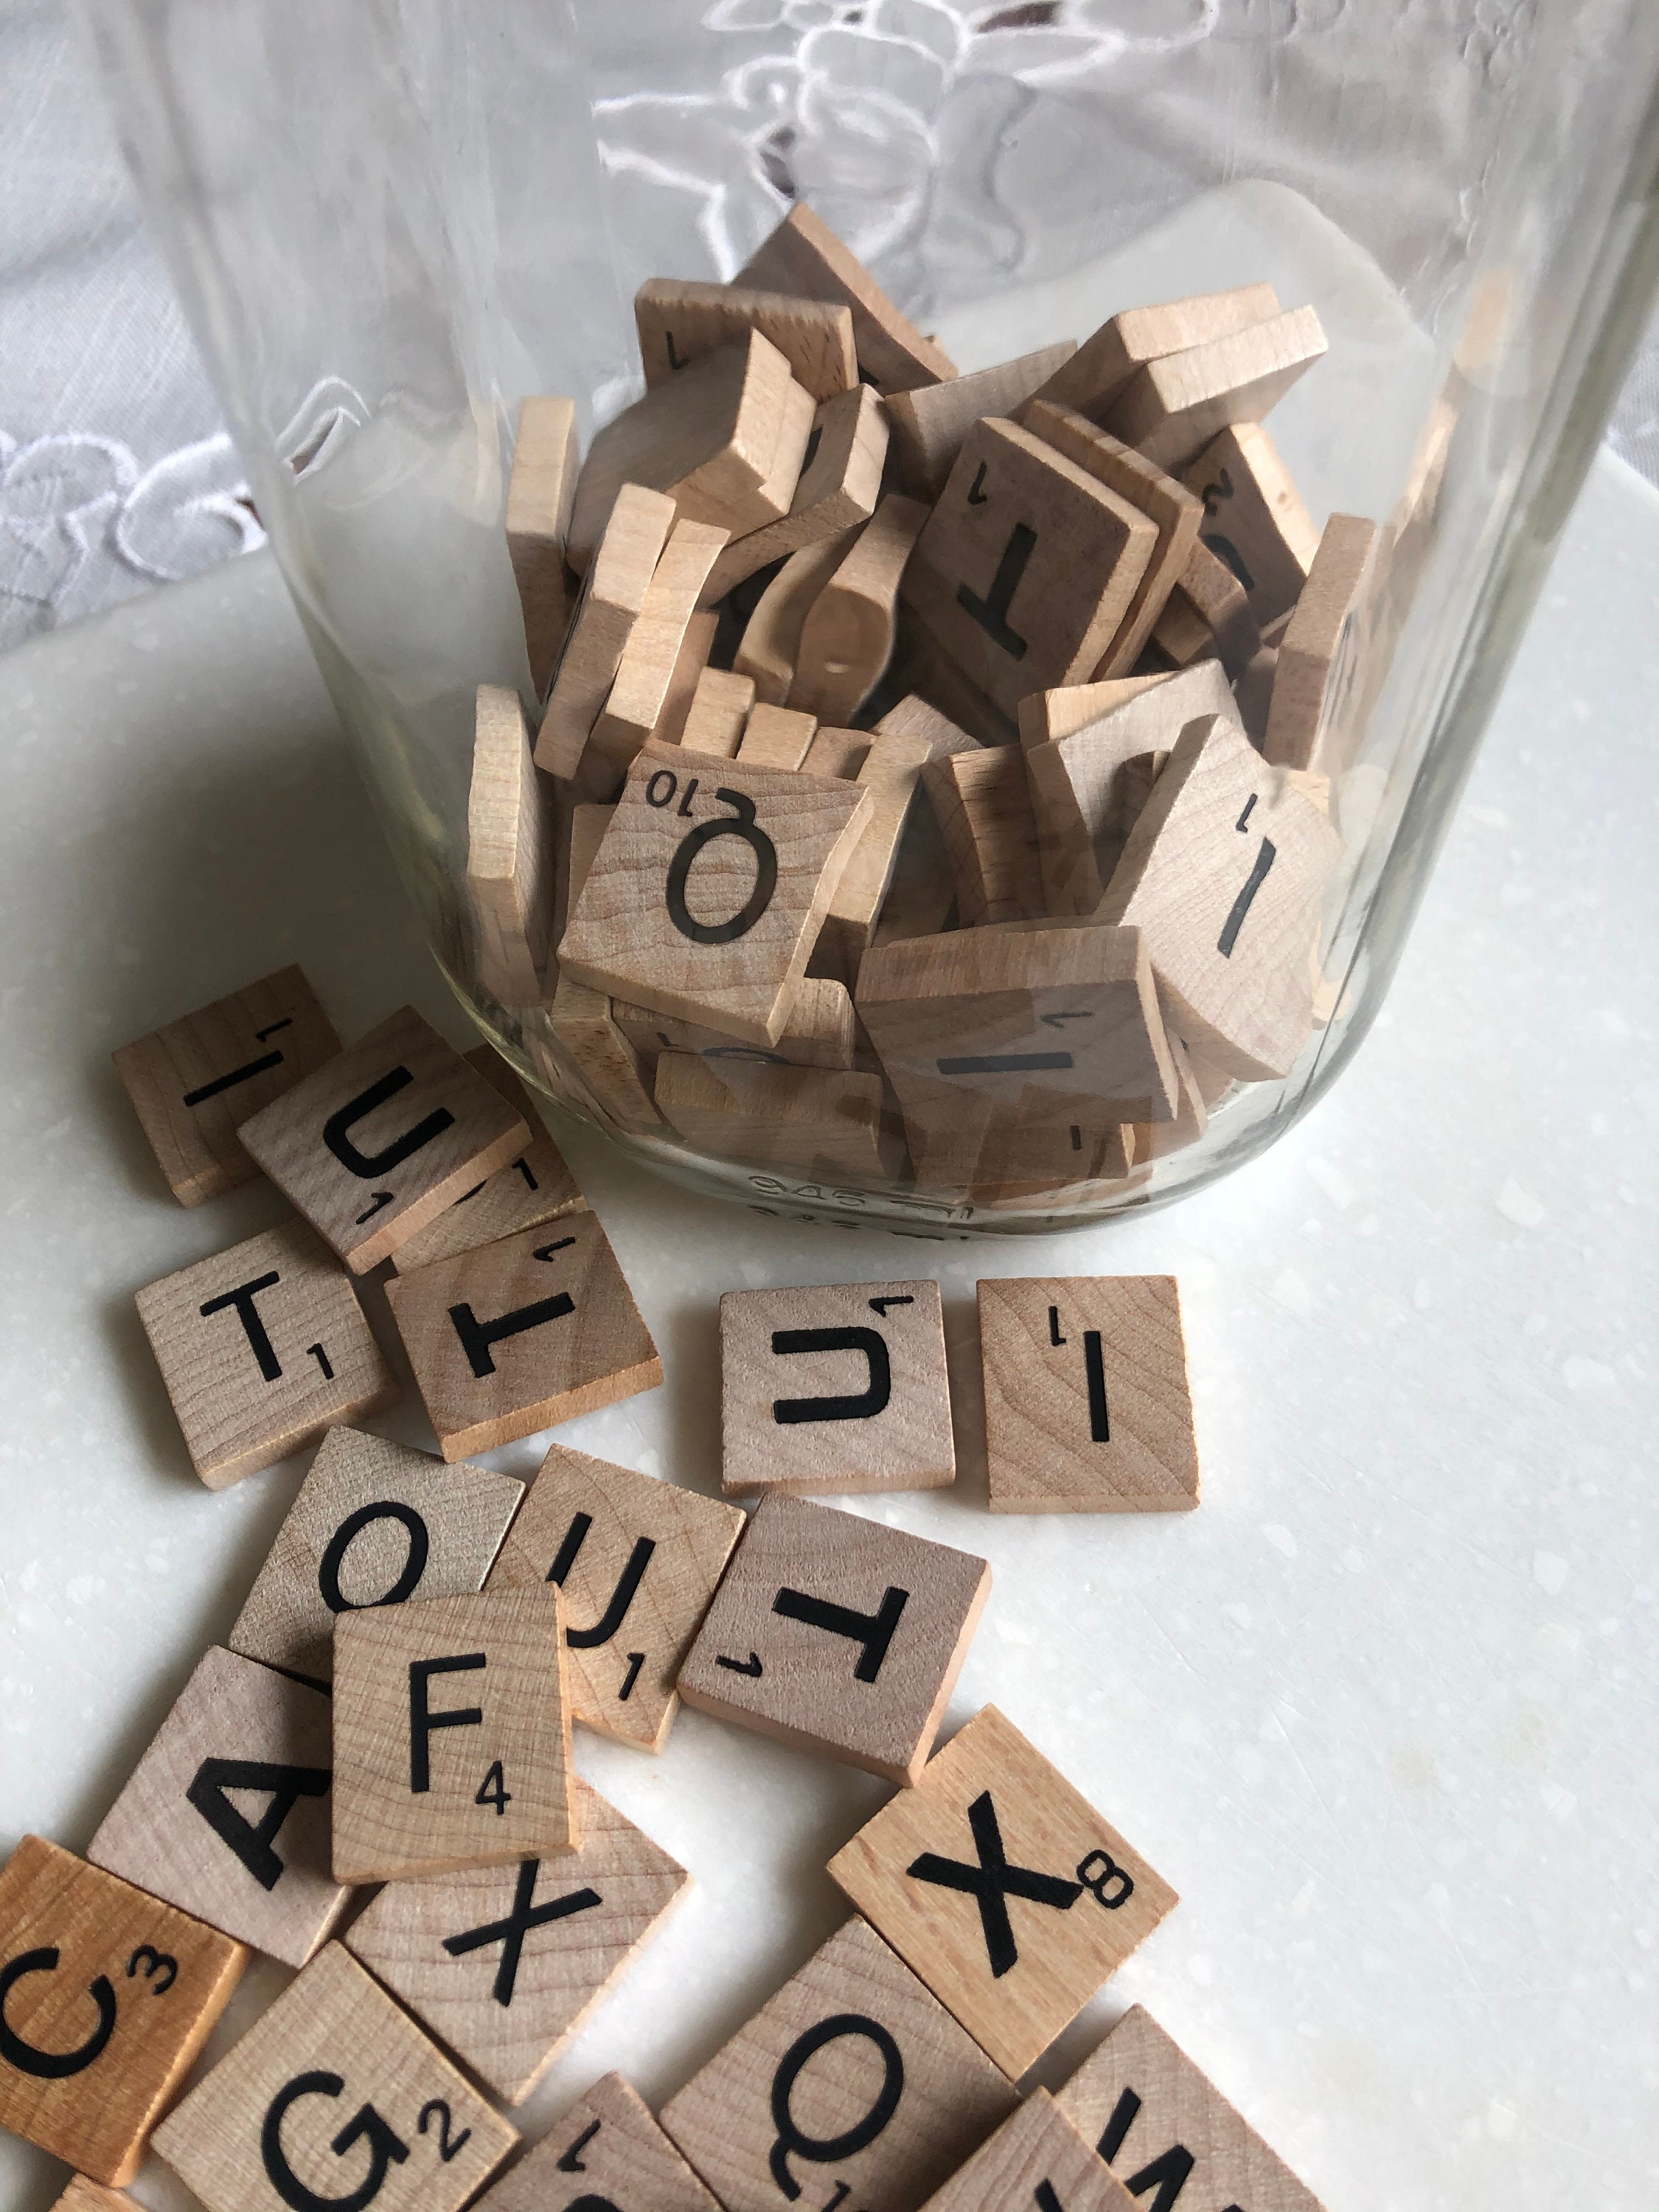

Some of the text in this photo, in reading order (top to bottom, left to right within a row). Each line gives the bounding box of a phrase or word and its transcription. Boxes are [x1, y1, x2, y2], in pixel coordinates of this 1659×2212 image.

[955, 521, 1039, 662] T
[645, 769, 779, 945] Q 10
[323, 1065, 456, 1225] U 1
[199, 1270, 334, 1382] T 1
[448, 1237, 577, 1379] T 1
[771, 1295, 914, 1425] U 1
[1048, 1305, 1067, 1347] 1
[319, 1500, 429, 1614] O
[618, 1652, 646, 1702] 1
[714, 1586, 910, 1684] T 1
[408, 1652, 512, 1816] F 4
[186, 1757, 334, 1892] A
[905, 1790, 1135, 1980] X 8
[442, 1857, 603, 2008] X
[0, 1944, 179, 2081] C 3
[260, 2070, 472, 2212] G 2
[557, 2118, 602, 2172] 1
[768, 2013, 905, 2202] Q
